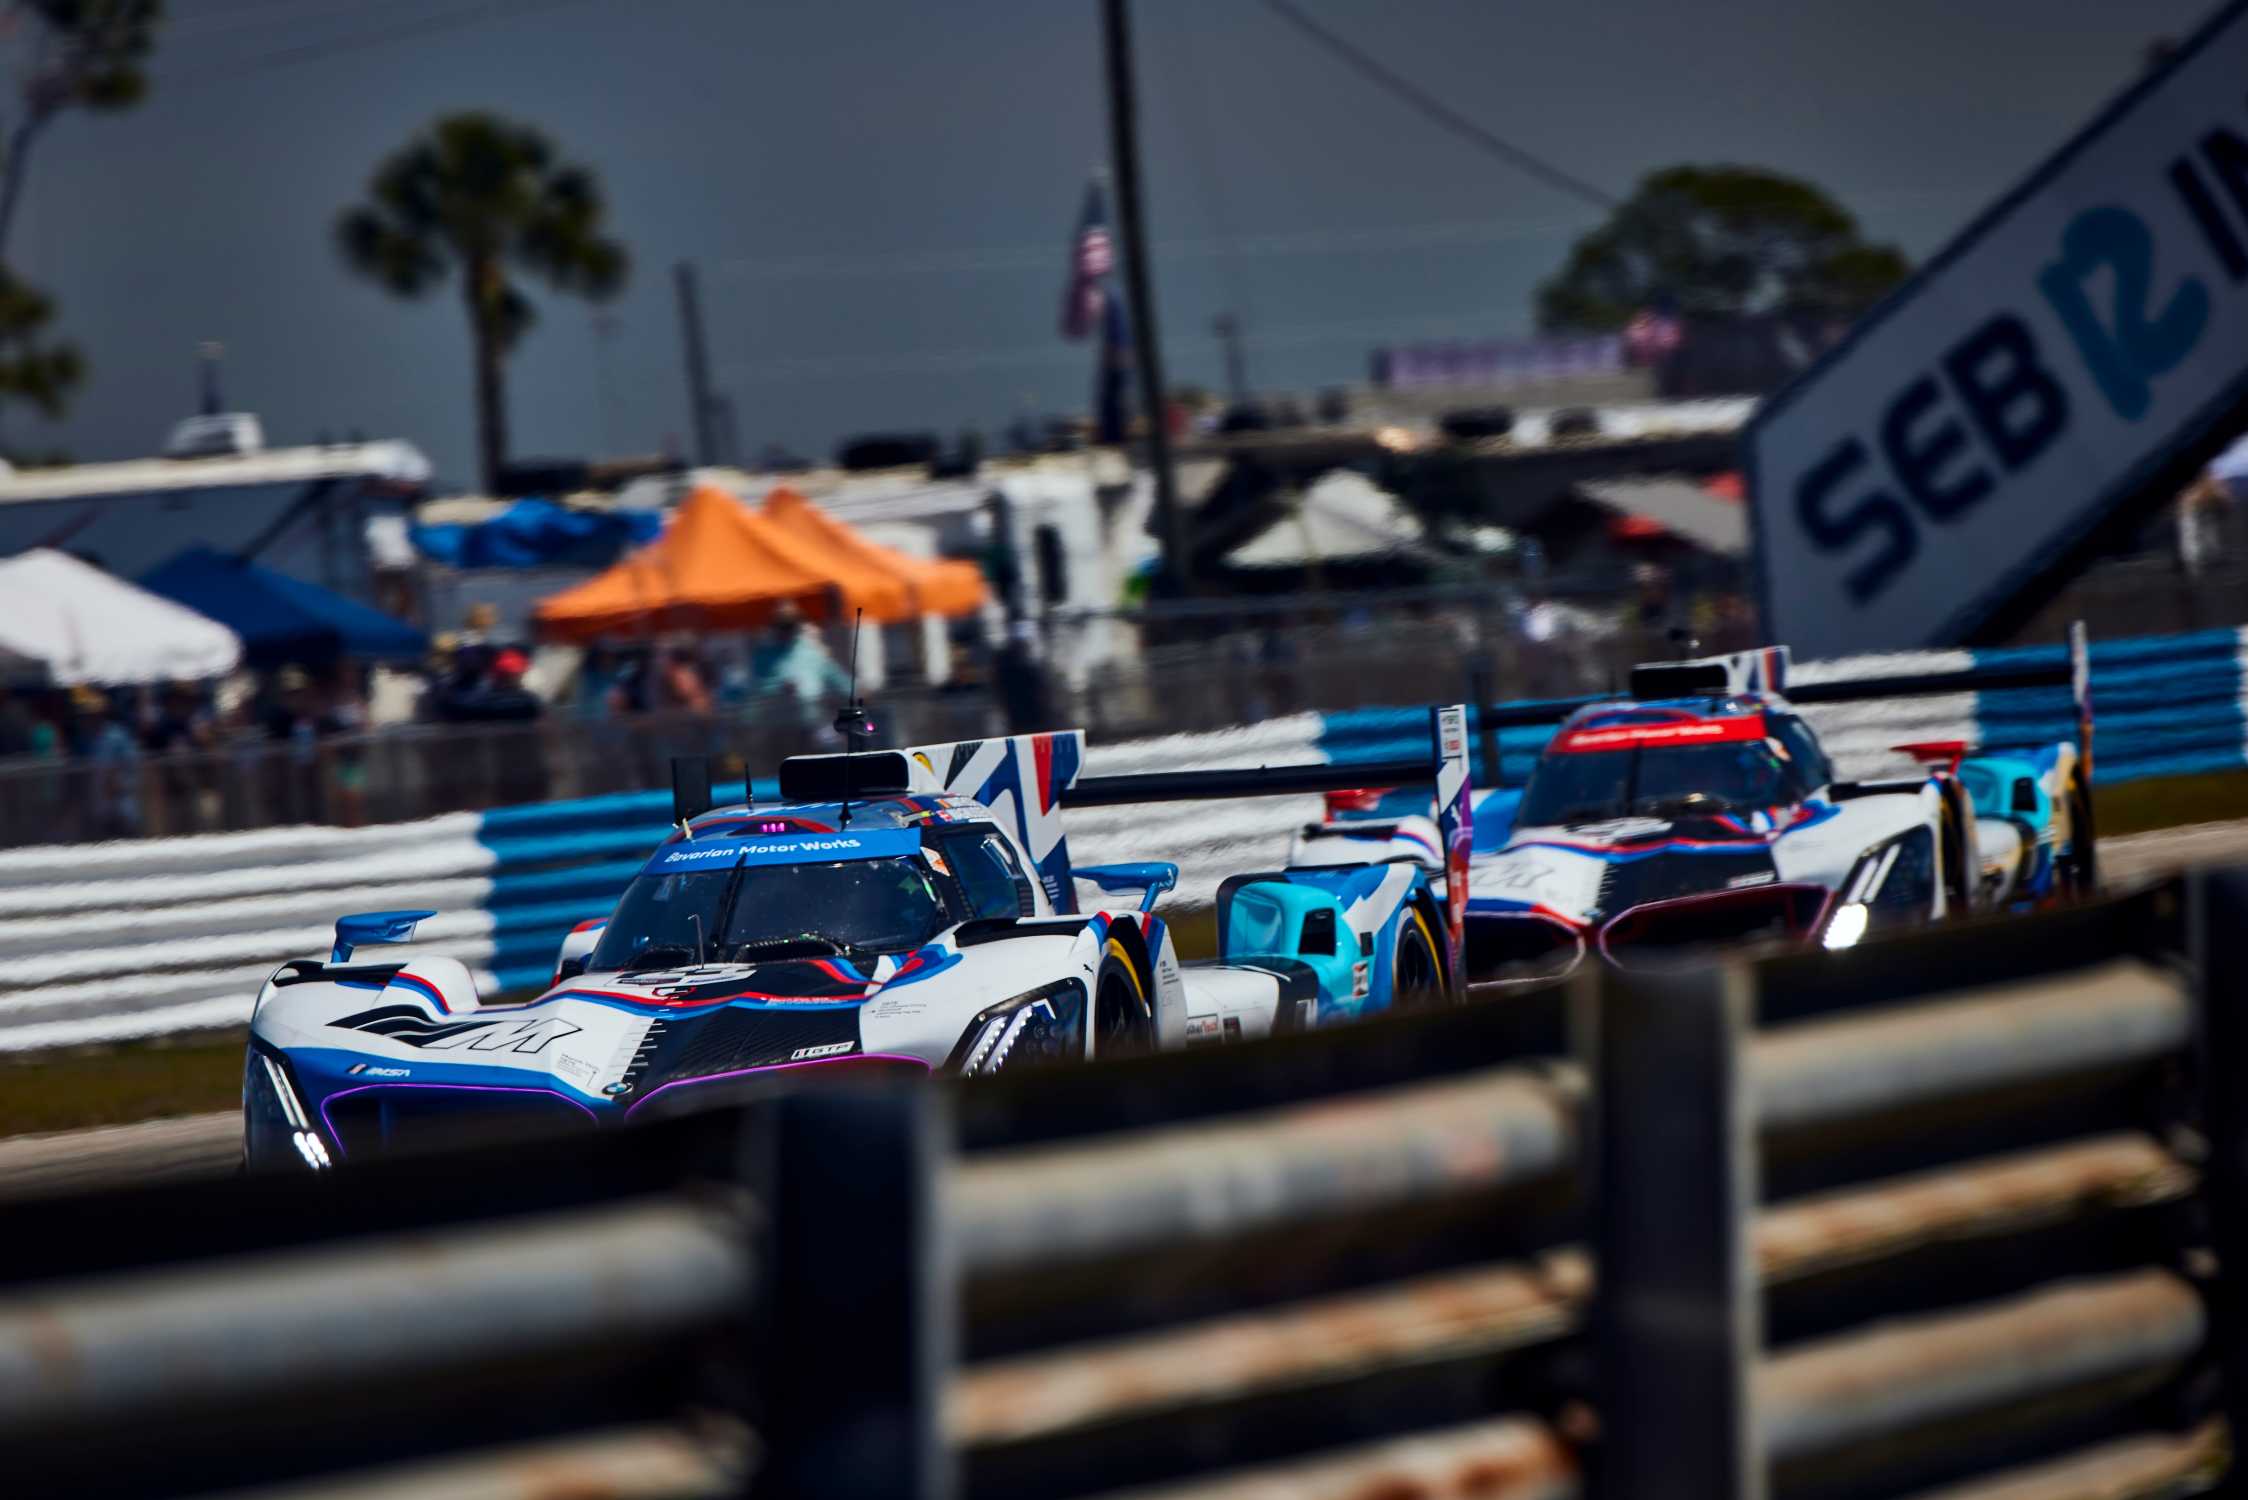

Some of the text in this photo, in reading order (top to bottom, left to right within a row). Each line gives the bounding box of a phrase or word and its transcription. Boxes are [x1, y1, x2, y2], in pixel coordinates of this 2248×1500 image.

[664, 838, 861, 863] Bavarian Motor Works
